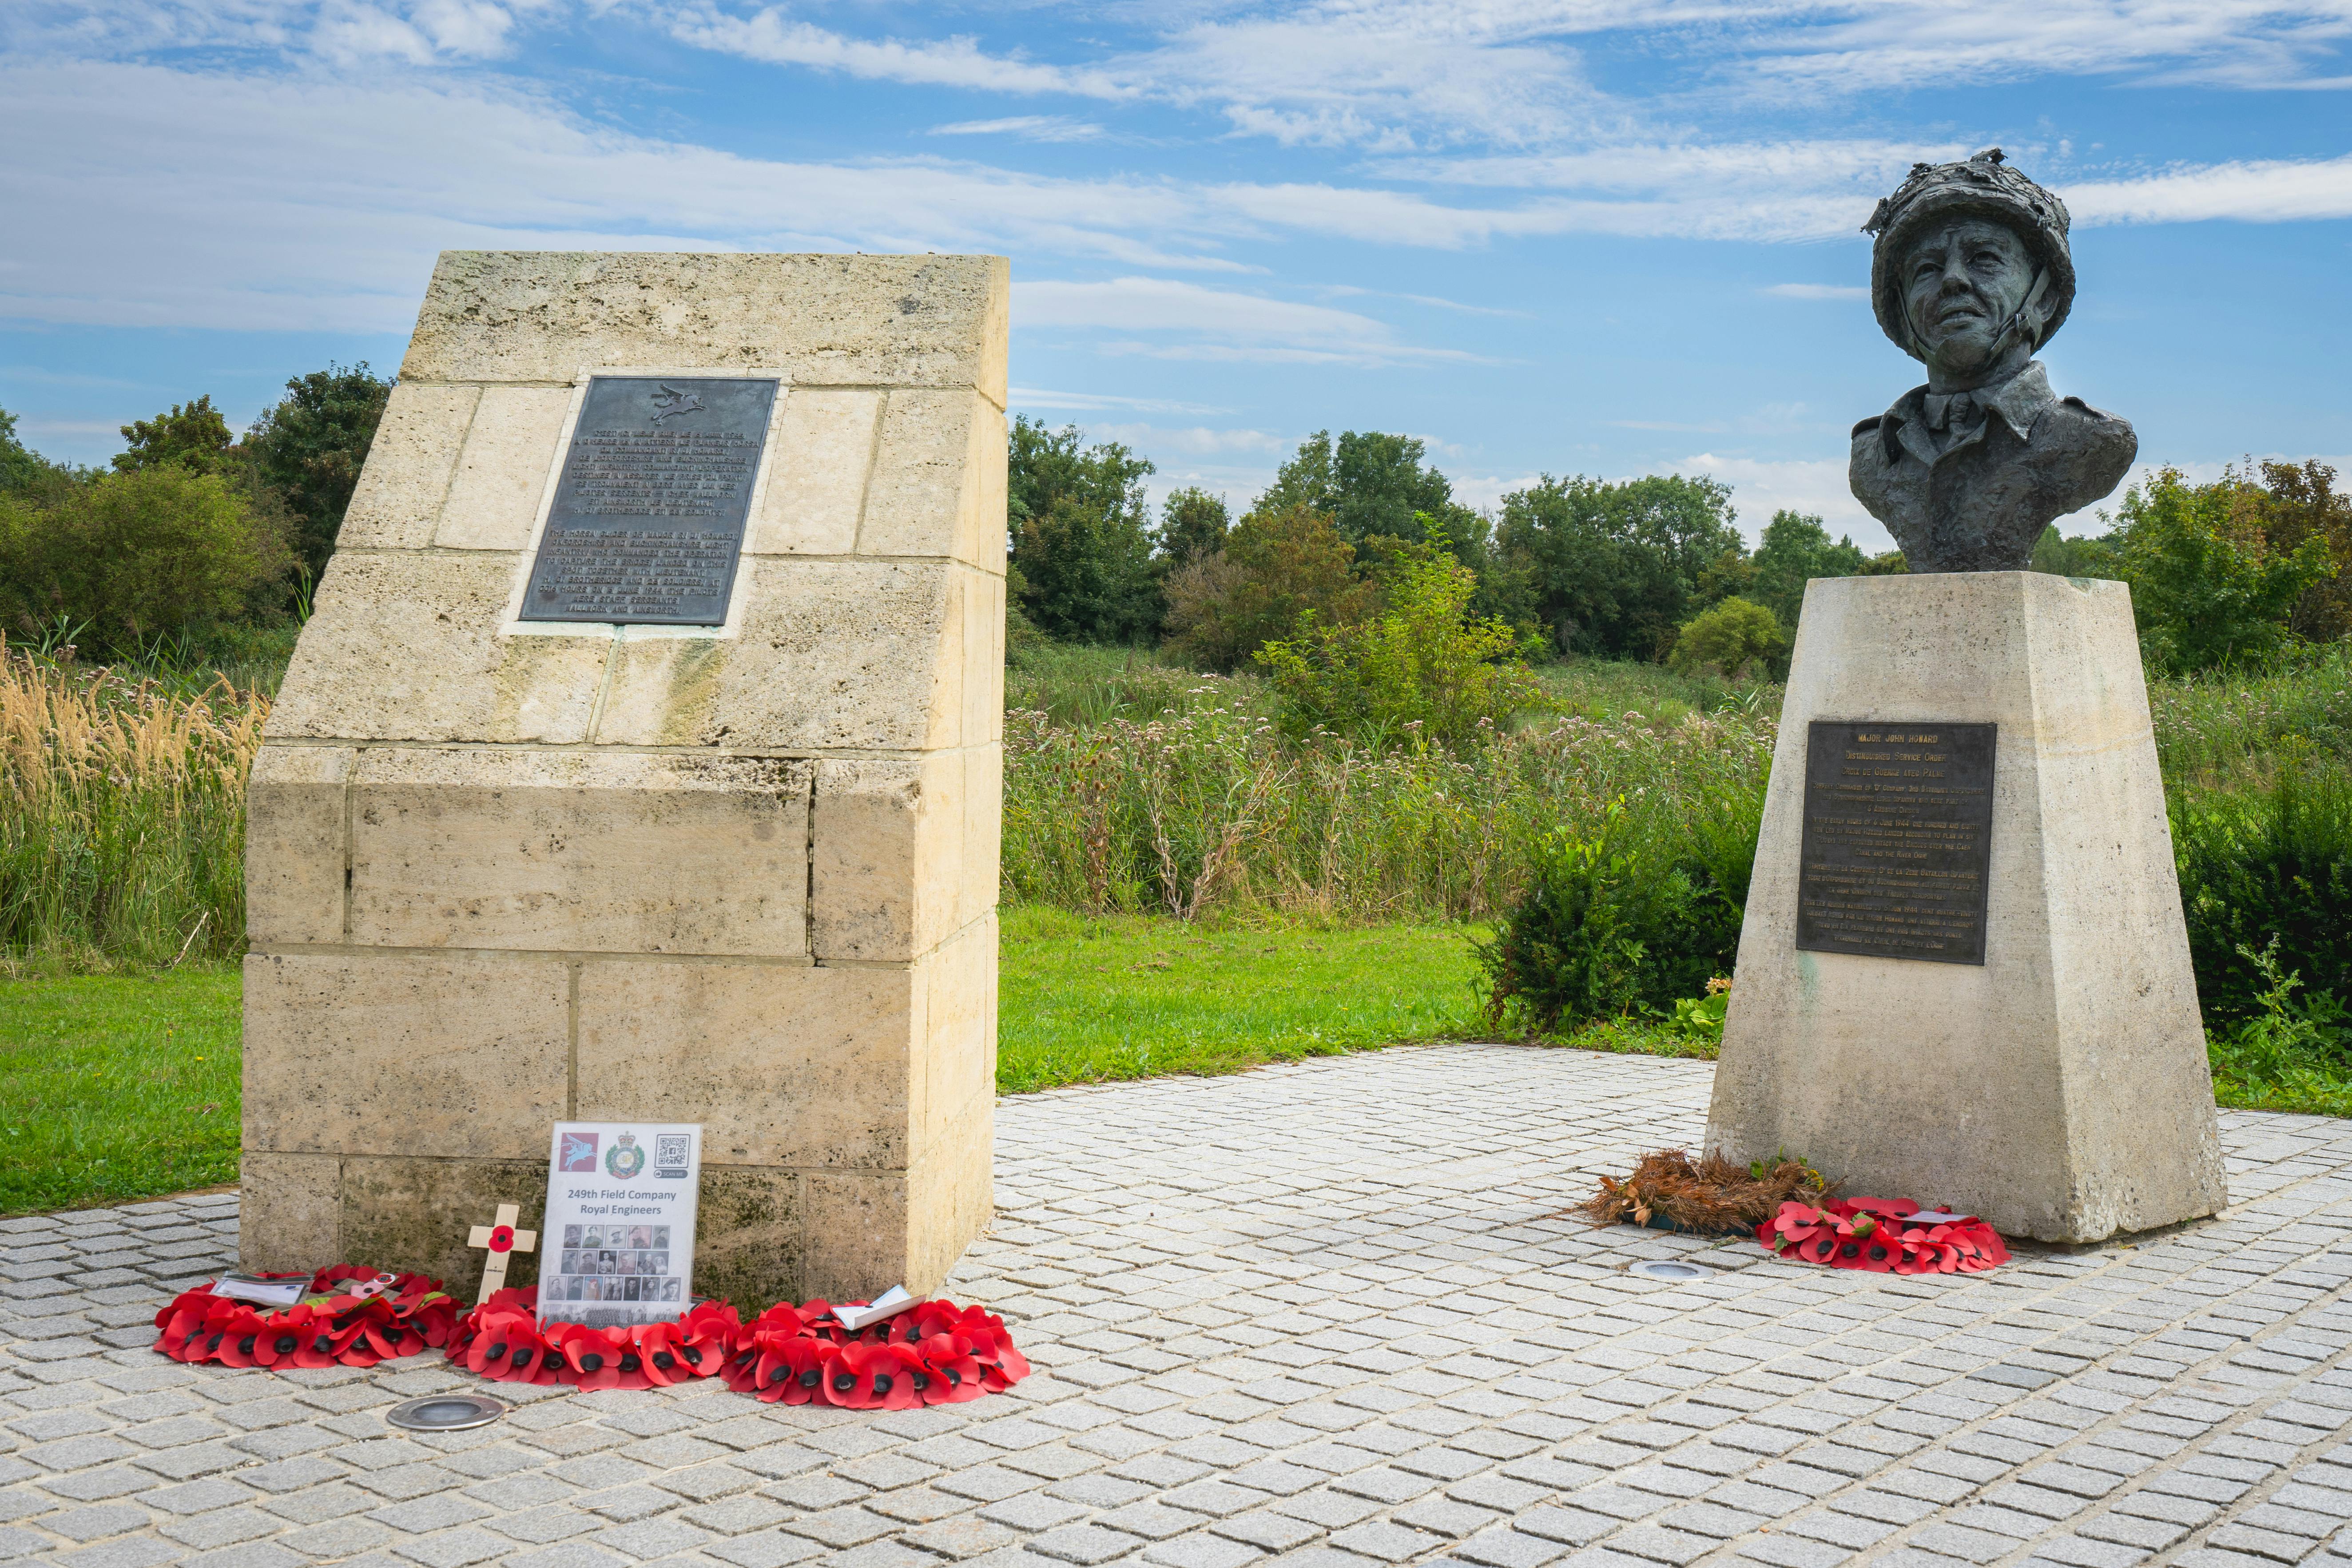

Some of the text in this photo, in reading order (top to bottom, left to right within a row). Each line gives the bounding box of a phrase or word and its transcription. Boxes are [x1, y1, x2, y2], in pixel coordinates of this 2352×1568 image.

[1858, 734, 1938, 743] MAJOR JOHN HOWARD
[1845, 750, 1947, 762] DISTINGUISHED SERVICE ORDER
[1841, 766, 1859, 775] CROIX
[1923, 768, 1946, 778] PALME
[568, 1189, 676, 1201] 249th Field Company
[581, 1205, 661, 1215] Royal Engineers
